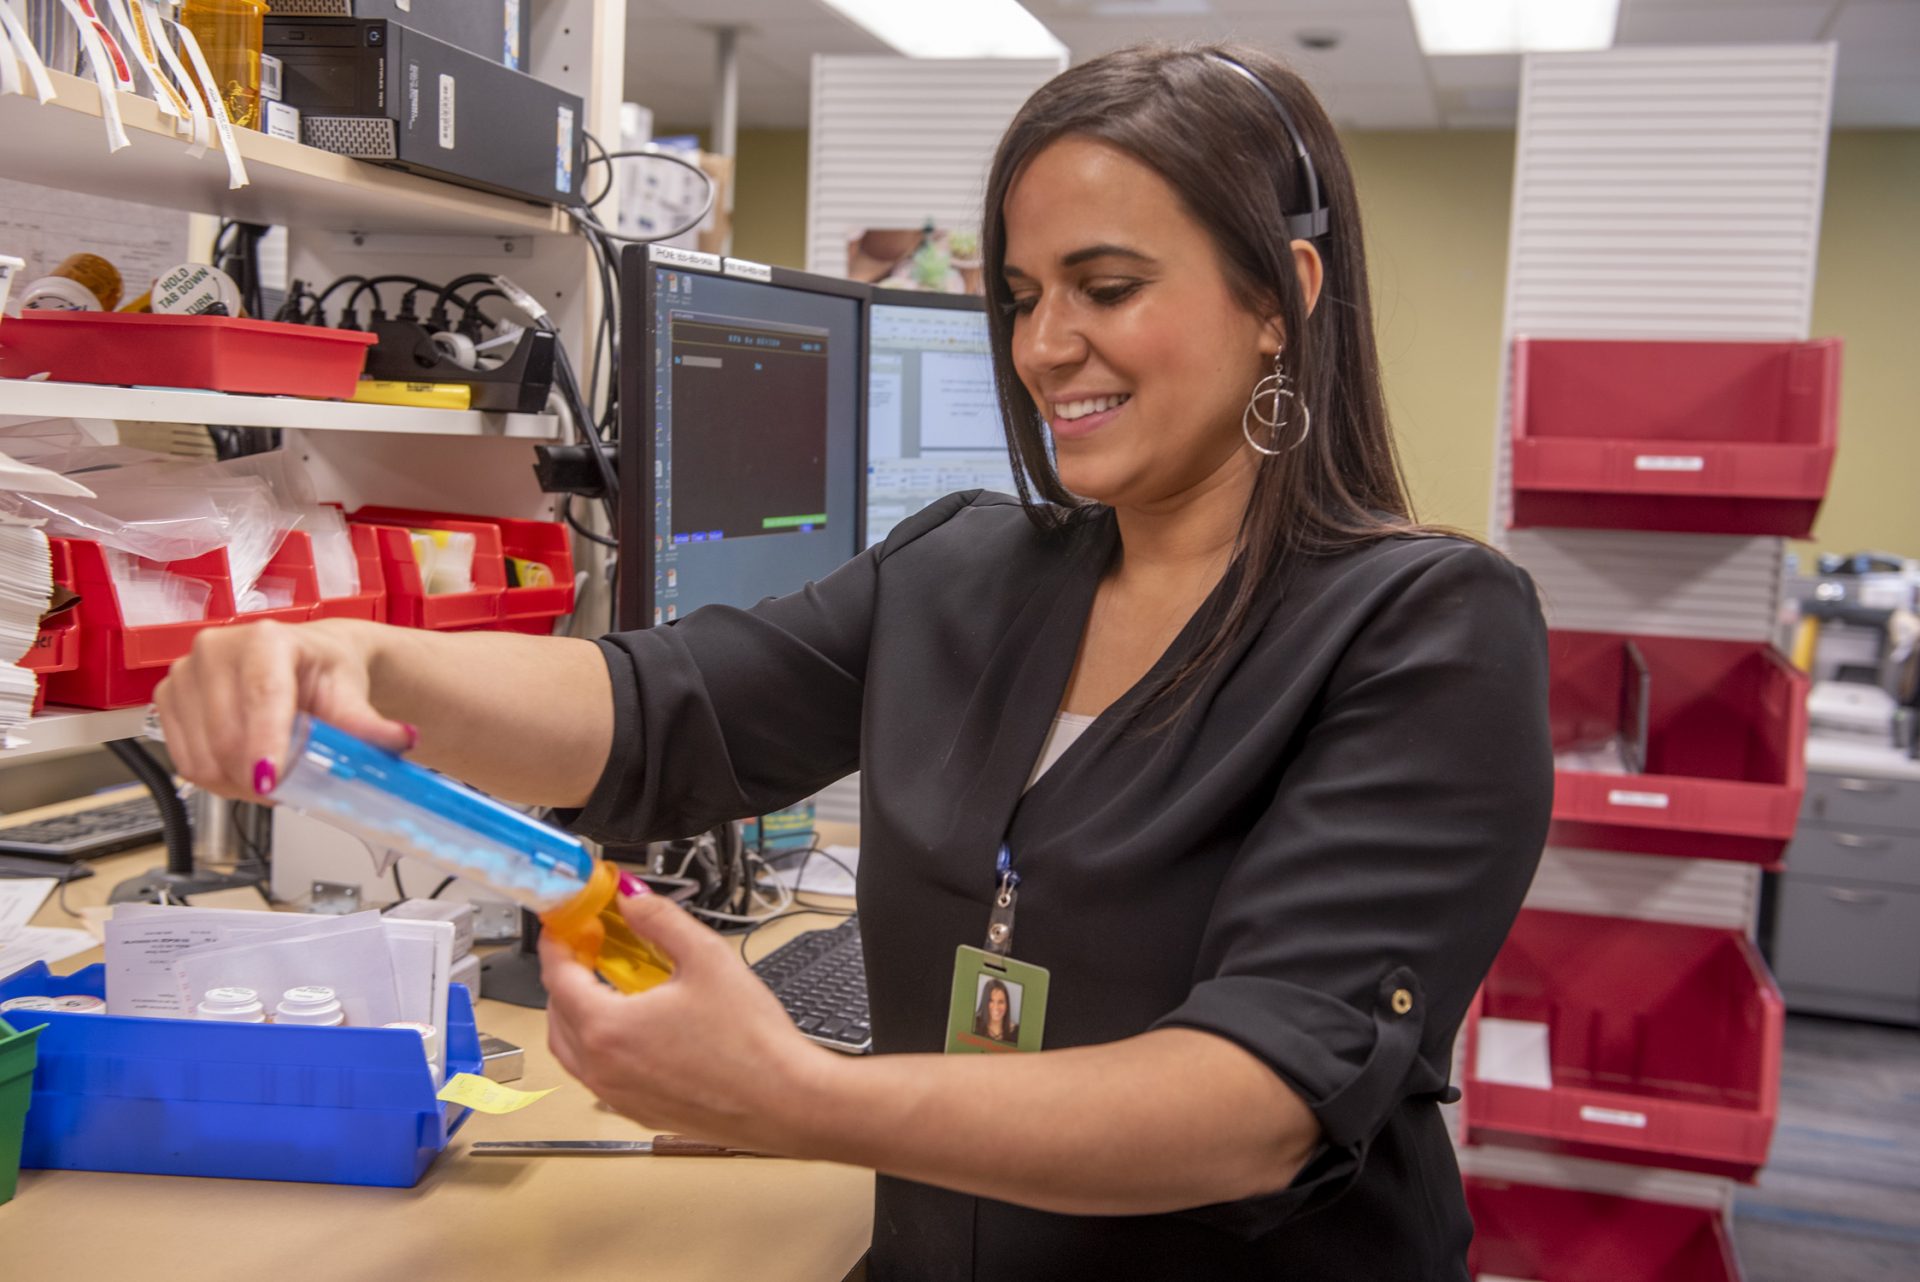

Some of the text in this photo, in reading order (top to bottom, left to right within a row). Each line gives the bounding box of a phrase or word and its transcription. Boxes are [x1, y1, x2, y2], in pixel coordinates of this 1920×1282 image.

[158, 267, 209, 309] TAB DOWN
[160, 267, 190, 292] HOLD
[185, 292, 214, 315] TURN
